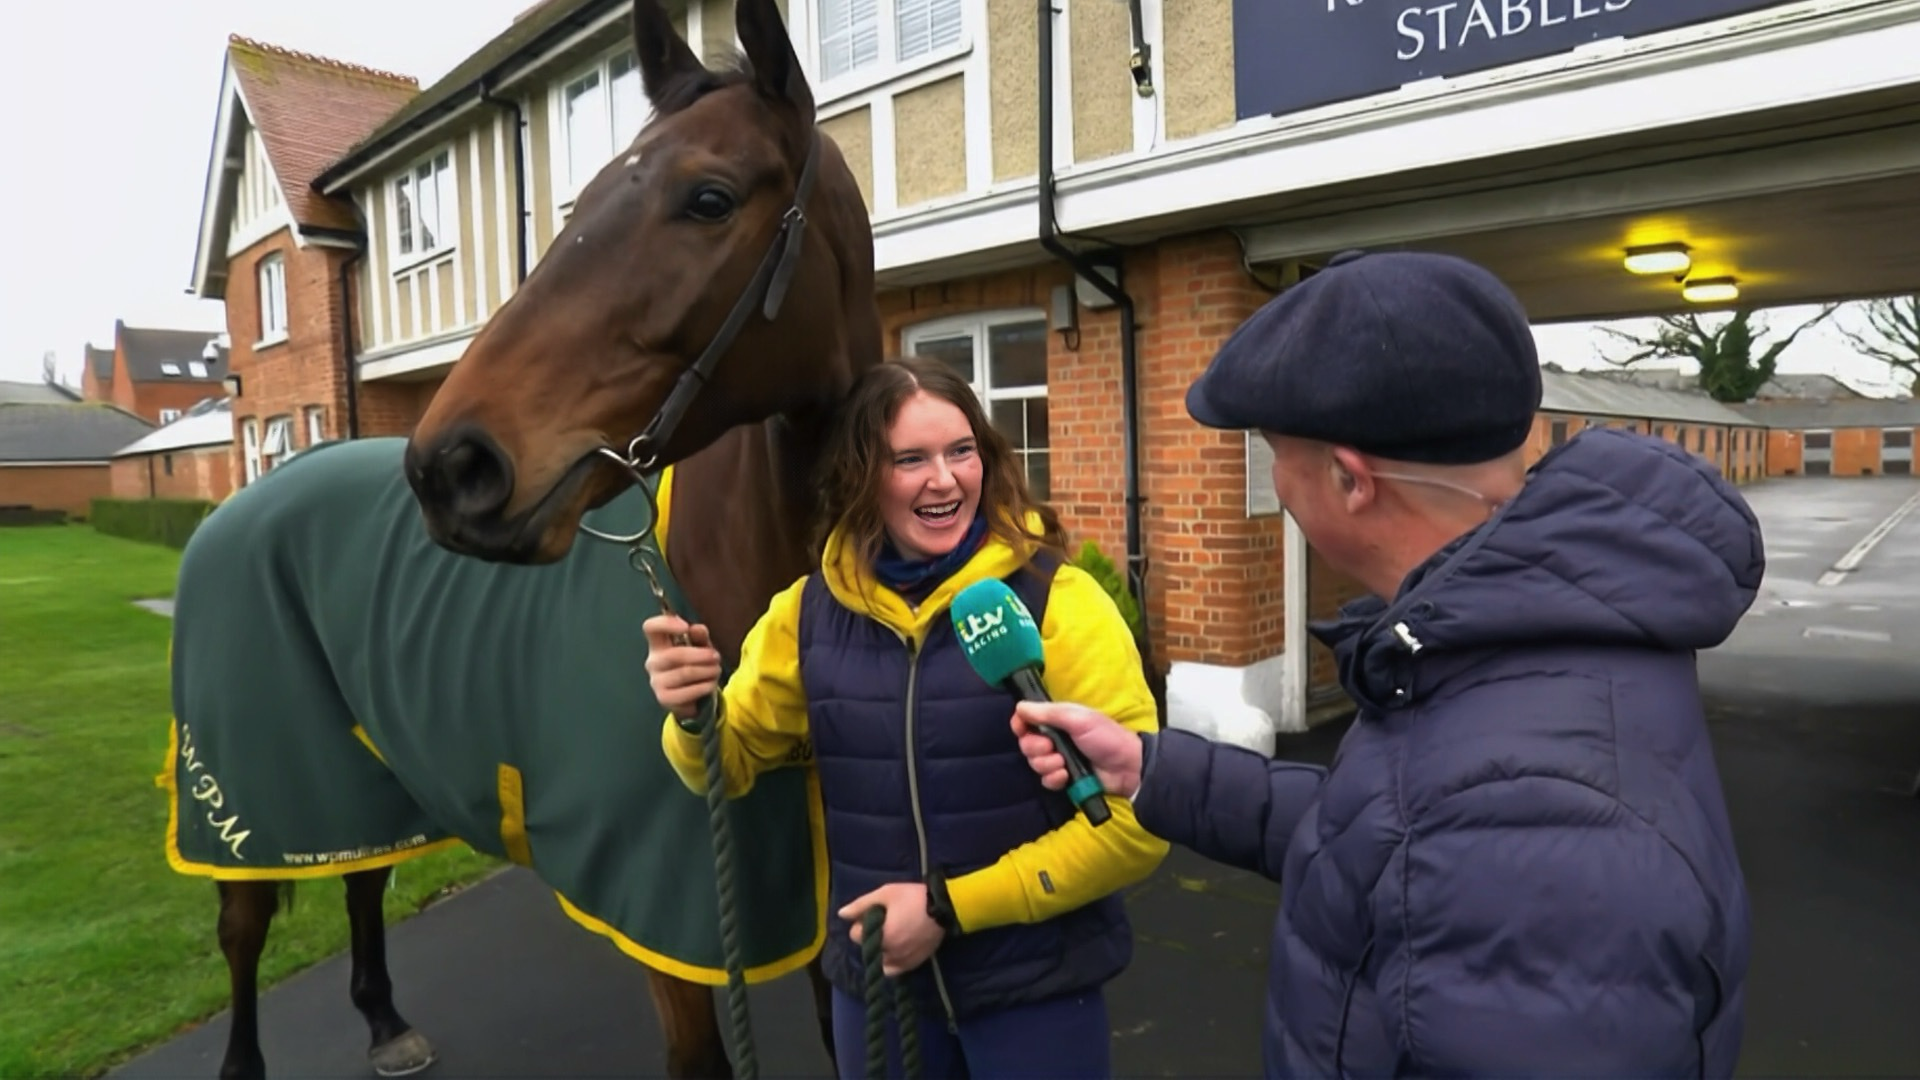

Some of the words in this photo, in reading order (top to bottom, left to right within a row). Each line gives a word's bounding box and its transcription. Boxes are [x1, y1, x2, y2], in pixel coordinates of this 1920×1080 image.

[1397, 0, 1634, 61] STABL
[957, 605, 1004, 643] itv
[968, 625, 1008, 656] RACING
